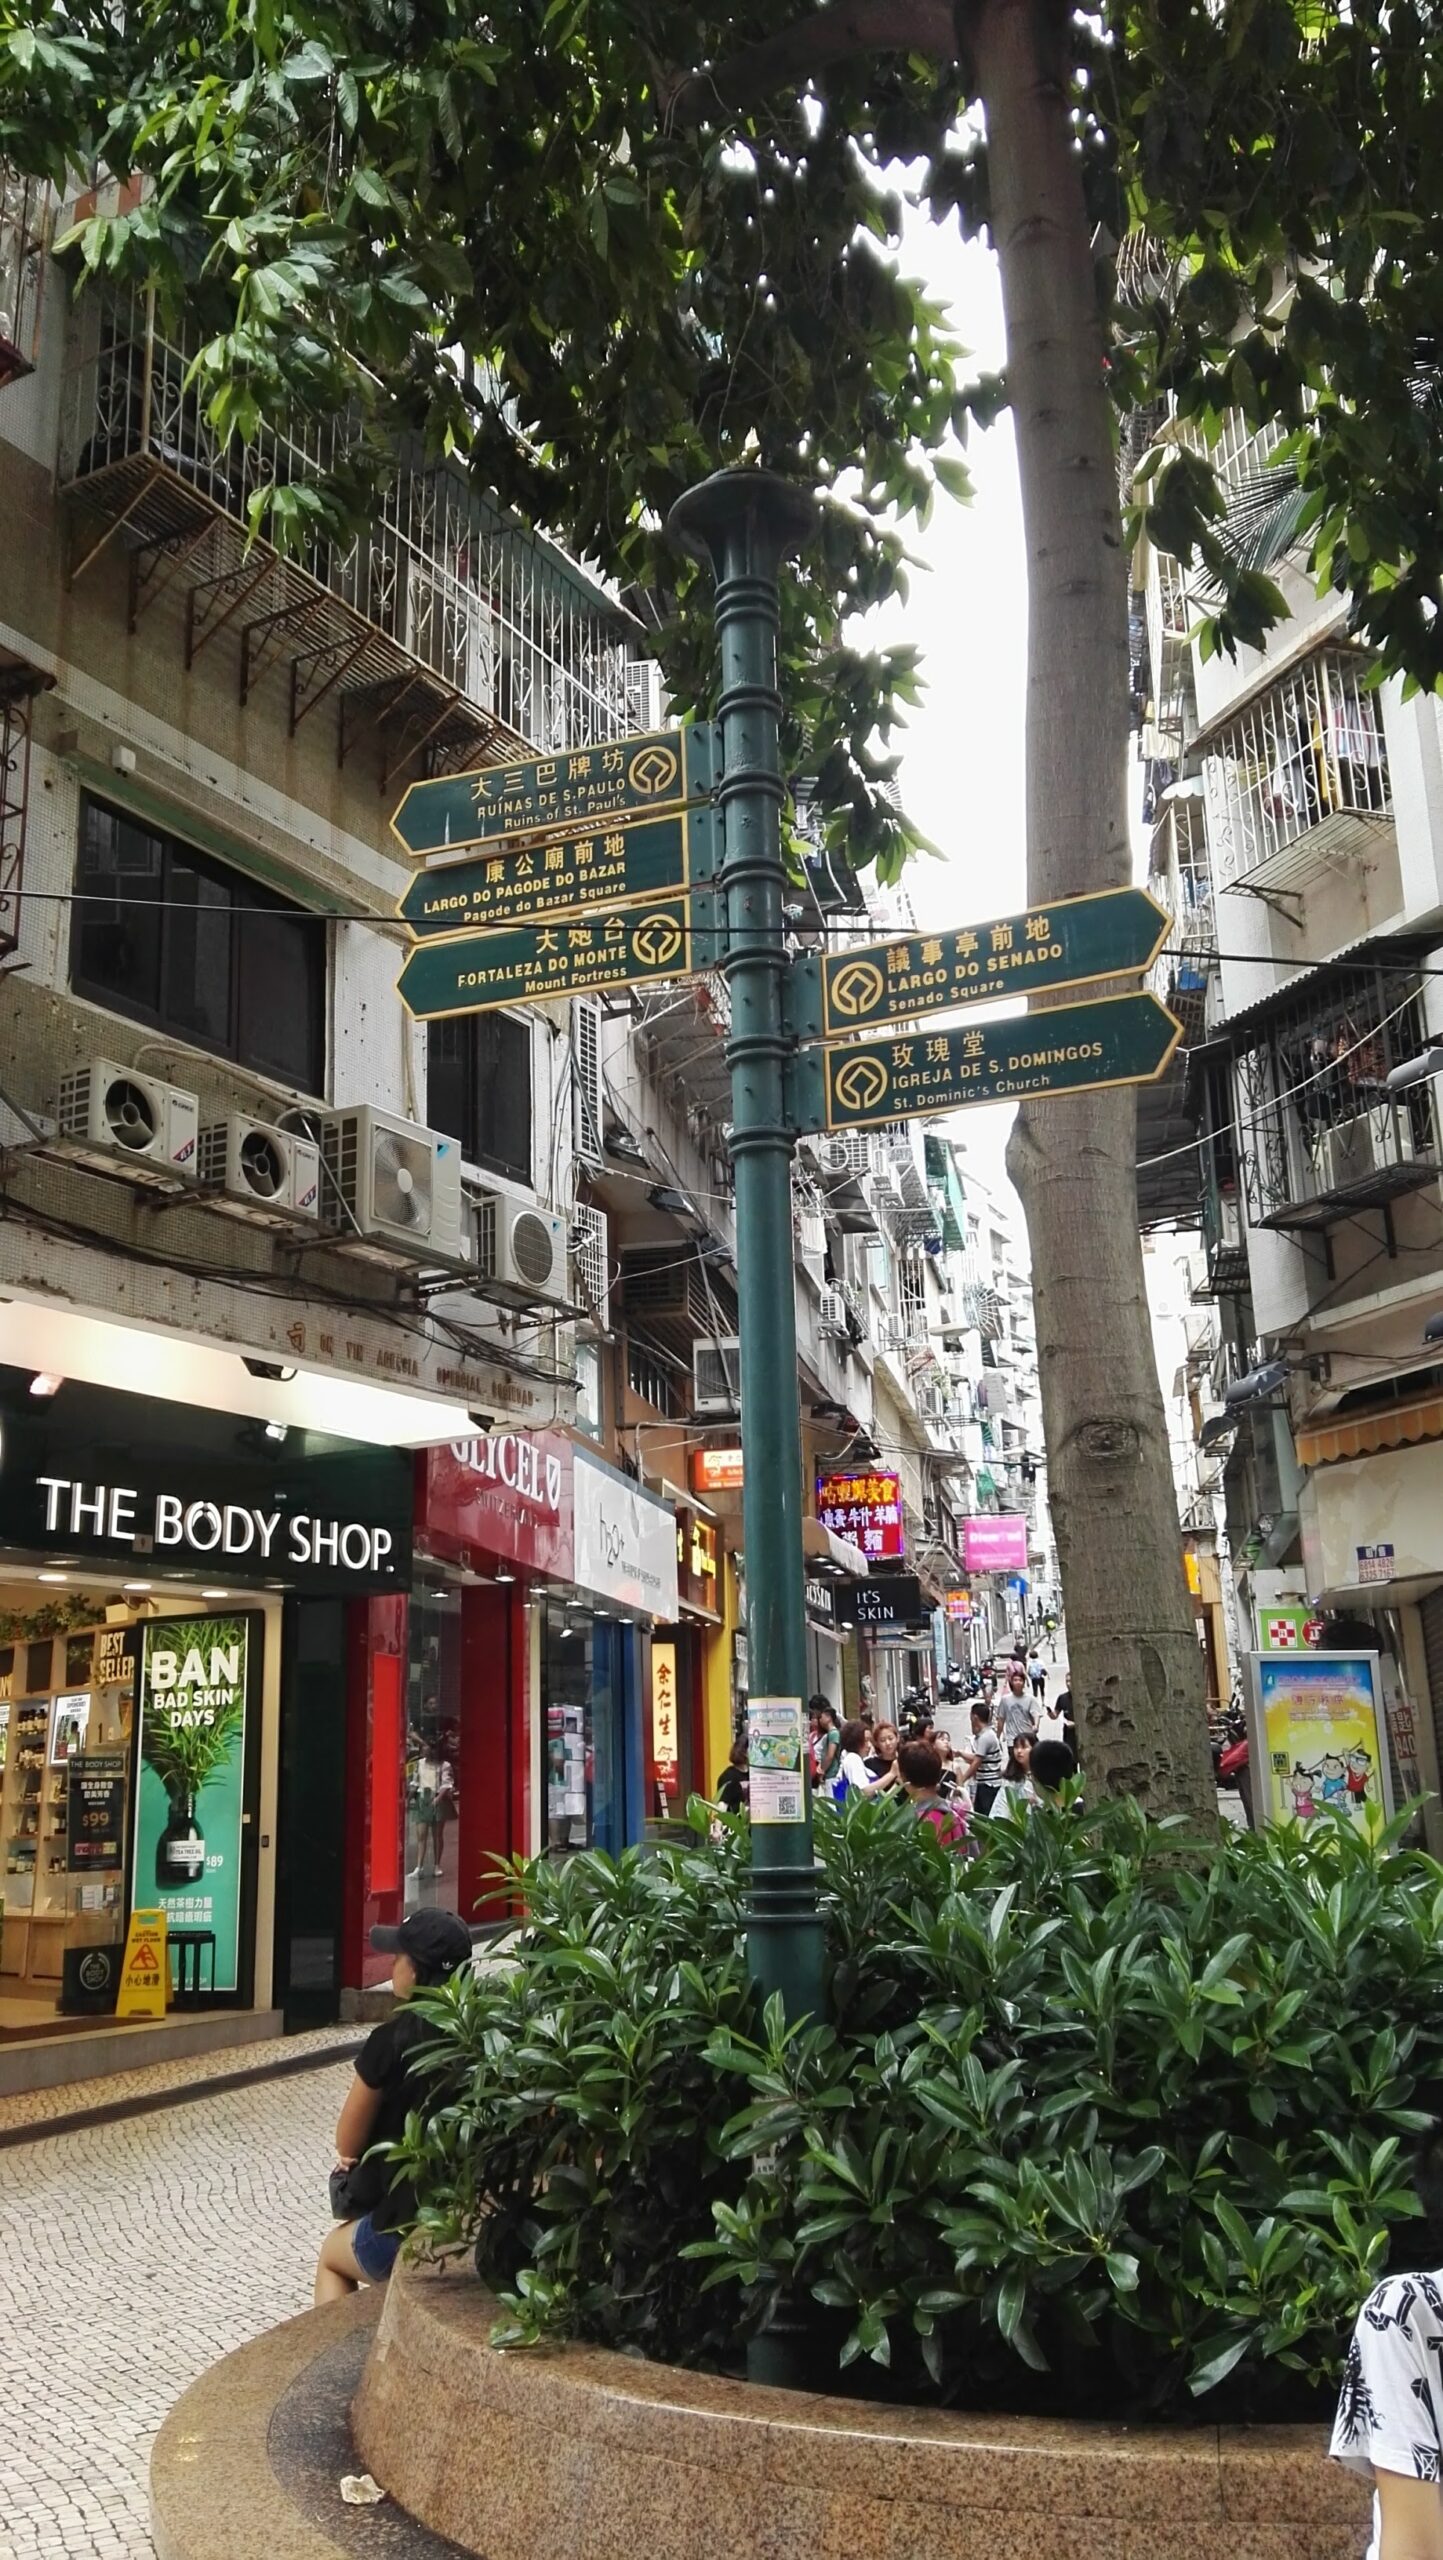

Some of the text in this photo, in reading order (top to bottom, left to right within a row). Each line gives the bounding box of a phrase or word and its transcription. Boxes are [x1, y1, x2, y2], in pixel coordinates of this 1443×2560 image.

[471, 749, 625, 801] 大三巴牌坊
[539, 793, 558, 807] DE
[563, 778, 626, 802] S.PAULO
[504, 794, 627, 829] Ruins of St. Paul's
[485, 833, 626, 884] 康公廟前地
[424, 862, 626, 914] LARGO DO PAGODE DO BAZAR
[463, 881, 627, 923] Pagode do Bazar Square
[535, 916, 627, 954] 大炮台
[886, 915, 1051, 975] 議事亭前地
[457, 945, 628, 987] FORTALEZA DO MONTE
[525, 967, 628, 993] Mount Fortress
[888, 944, 1063, 994] LARGO DO SENADO
[889, 979, 1005, 1012] Senado Square
[892, 1030, 986, 1069] 玫瑰堂
[893, 1042, 1104, 1090] IGREJA DE S. DOMINGOS
[893, 1074, 1051, 1110] St. Dominic's Church
[36, 1477, 138, 1541] THE
[155, 1494, 281, 1558] BODY
[857, 1606, 894, 1621] SKIN
[100, 1631, 126, 1658] BEST
[150, 1645, 239, 1690] BAN
[153, 1688, 234, 1710] BAD SKIN
[656, 1663, 672, 1736] 余仁生
[170, 1709, 215, 1728] DAYS
[71, 1759, 122, 1768] THE BODY SHOP
[82, 1812, 110, 1827] $99
[206, 1855, 224, 1867] $89
[125, 1973, 160, 1987] 小心地滑
